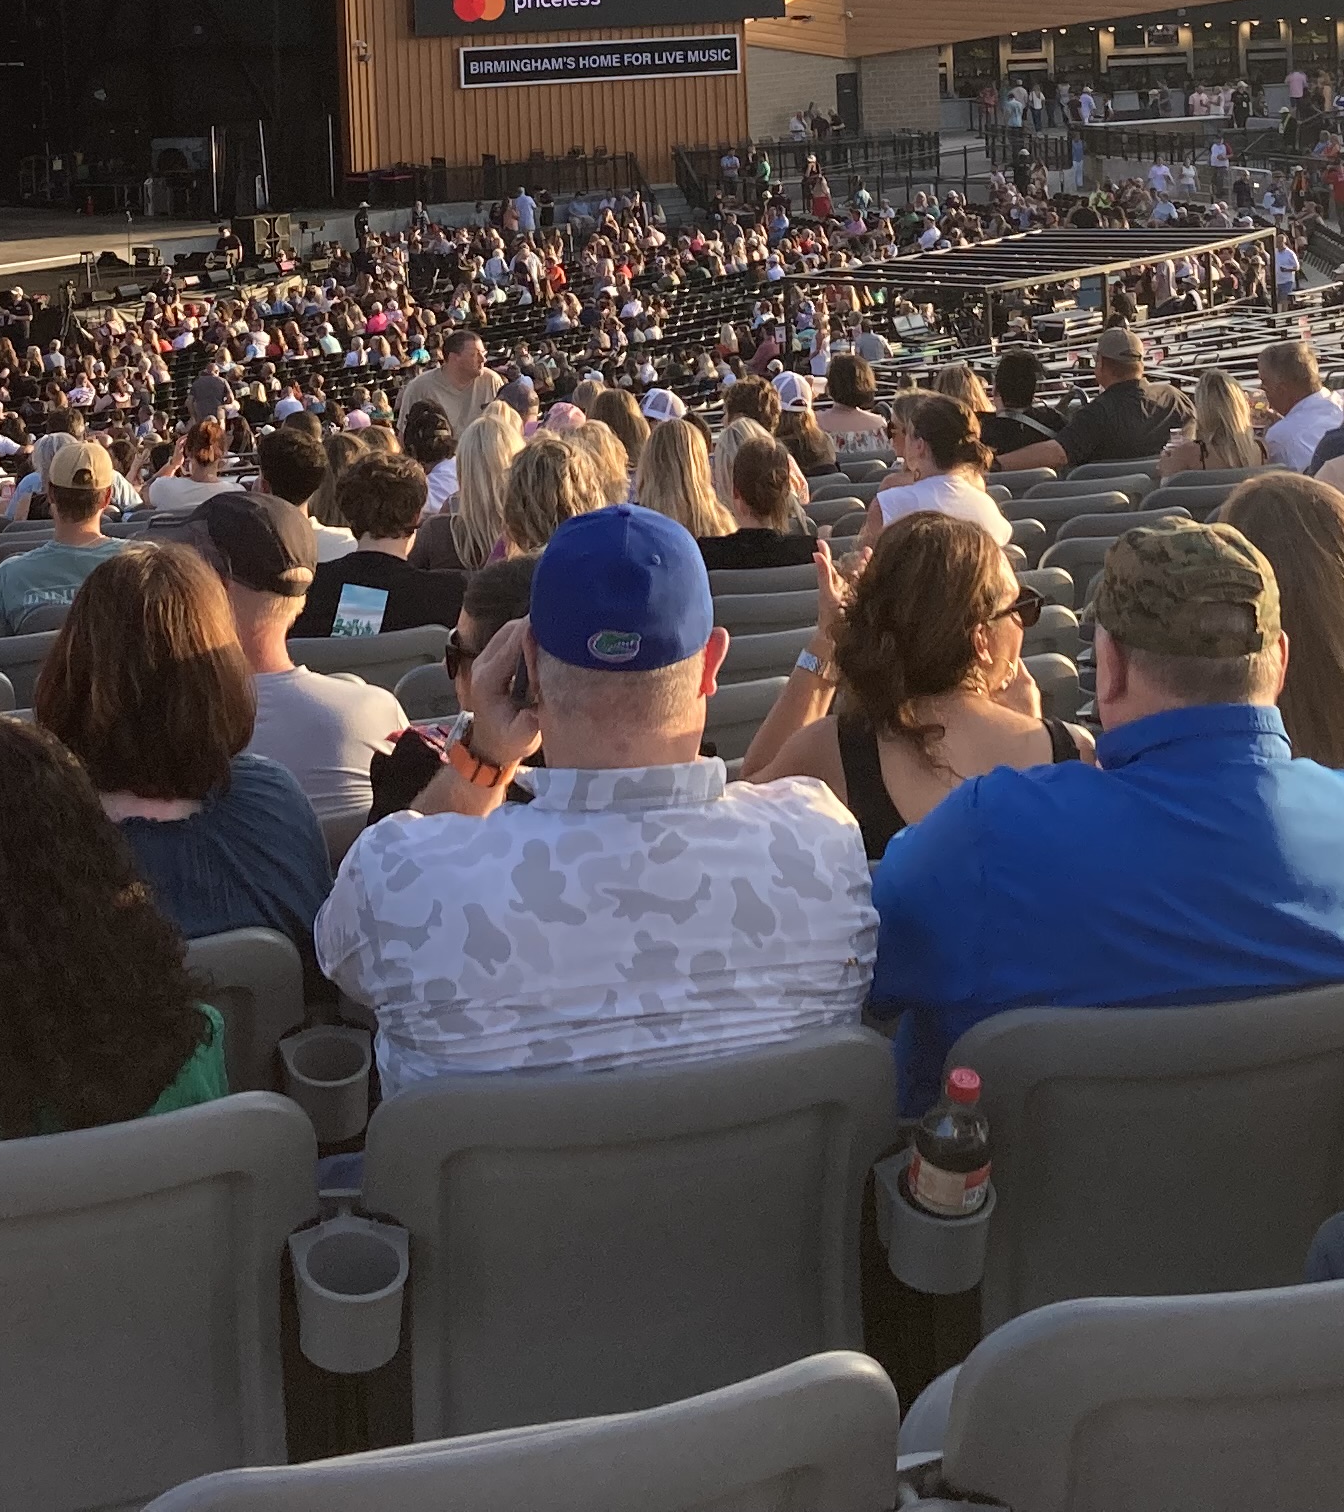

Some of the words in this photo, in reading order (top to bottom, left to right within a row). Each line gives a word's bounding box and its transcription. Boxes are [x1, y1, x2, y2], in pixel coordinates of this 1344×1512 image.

[470, 57, 576, 74] BIRMINGHAM'S
[579, 54, 621, 69] HOME
[624, 52, 651, 66] FOR
[654, 50, 684, 64] LIVE
[687, 48, 731, 63] MUSIC
